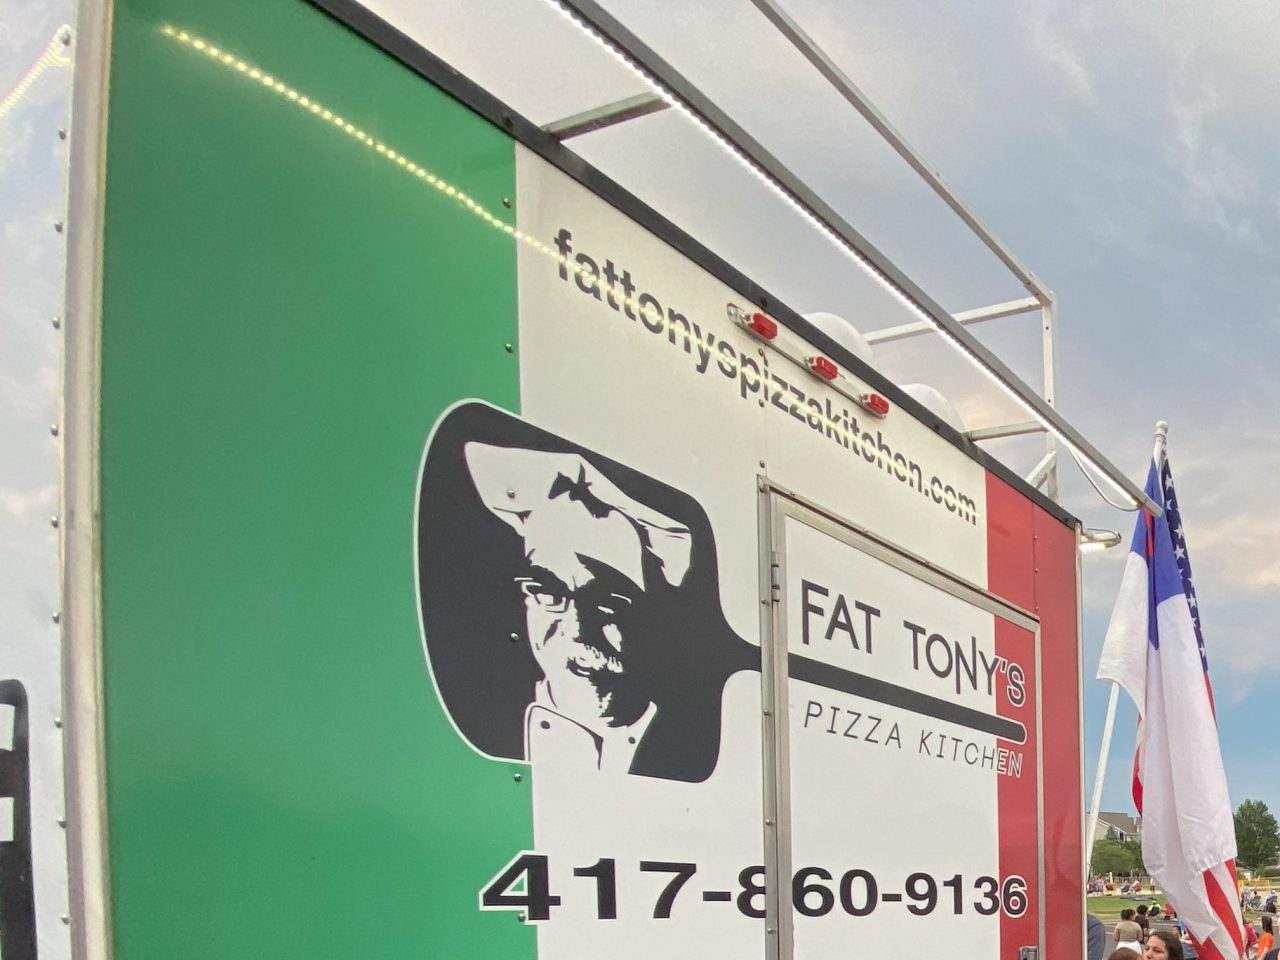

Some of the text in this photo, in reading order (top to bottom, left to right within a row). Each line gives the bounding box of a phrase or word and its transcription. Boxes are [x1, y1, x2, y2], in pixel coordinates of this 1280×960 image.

[553, 228, 978, 526] fattonyspizzakitchen.com
[801, 578, 1026, 707] FAT TONY'S
[804, 700, 1023, 778] PIZZA KITCHEN
[478, 850, 1029, 926] 417-860-9136
